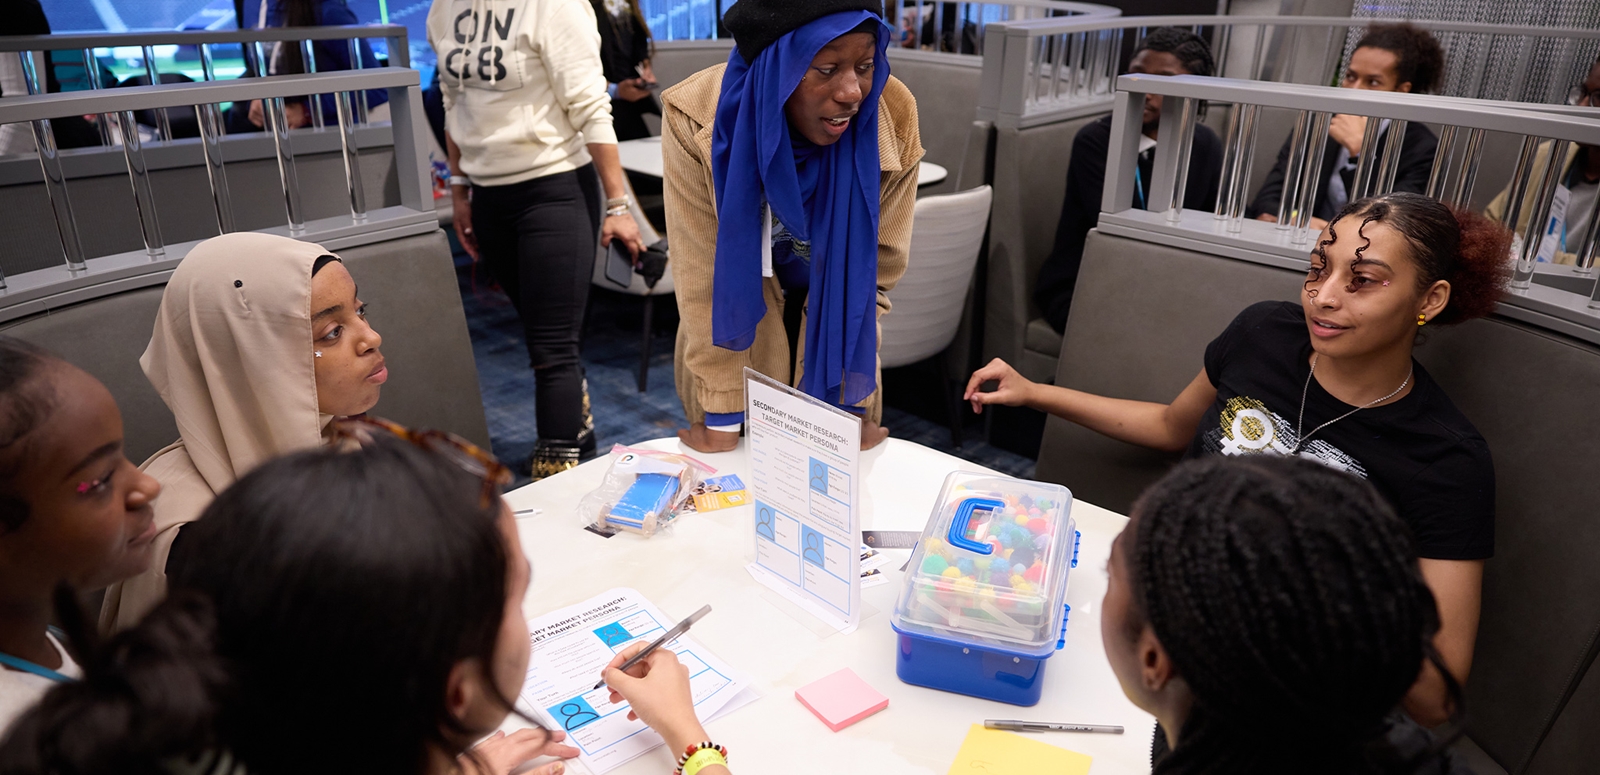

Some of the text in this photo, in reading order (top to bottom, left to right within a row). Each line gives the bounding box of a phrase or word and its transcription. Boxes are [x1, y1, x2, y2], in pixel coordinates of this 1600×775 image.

[454, 8, 515, 44] ON
[752, 399, 786, 420] SECONDARY
[788, 414, 812, 430] MARKET
[813, 424, 849, 446] RESEARCH:
[762, 412, 784, 428] TARGET
[784, 423, 808, 438] MARKET
[810, 434, 839, 452] PERSONA
[530, 596, 628, 637] ARY MARKET RESEARCH:
[530, 634, 546, 644] GET
[547, 620, 582, 637] MARKET
[582, 606, 621, 623] PERSONA
